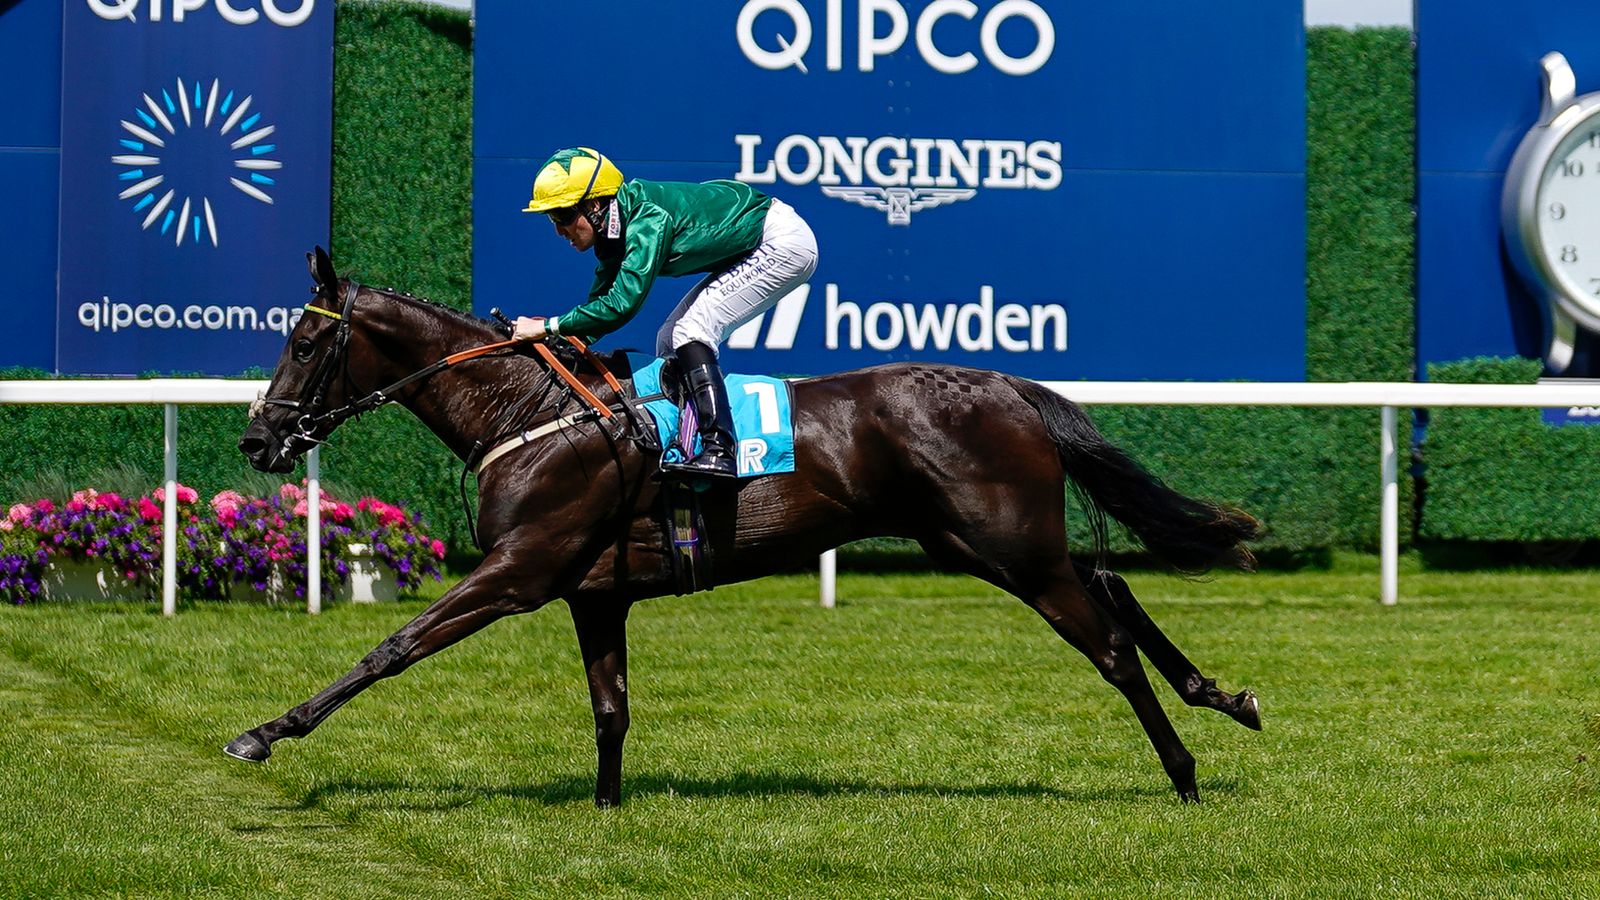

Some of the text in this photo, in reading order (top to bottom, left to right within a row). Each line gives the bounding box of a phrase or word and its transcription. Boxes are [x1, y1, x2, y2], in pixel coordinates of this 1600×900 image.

[736, 0, 1055, 76] QIPCO
[734, 134, 1063, 190] LONGINES
[1562, 161, 1584, 178] 10
[1550, 202, 1566, 221] 9
[1560, 244, 1578, 264] 8
[78, 296, 304, 337] qipco.com.qa
[825, 283, 1068, 352] howden
[743, 382, 782, 434] 1
[740, 438, 768, 475] R
